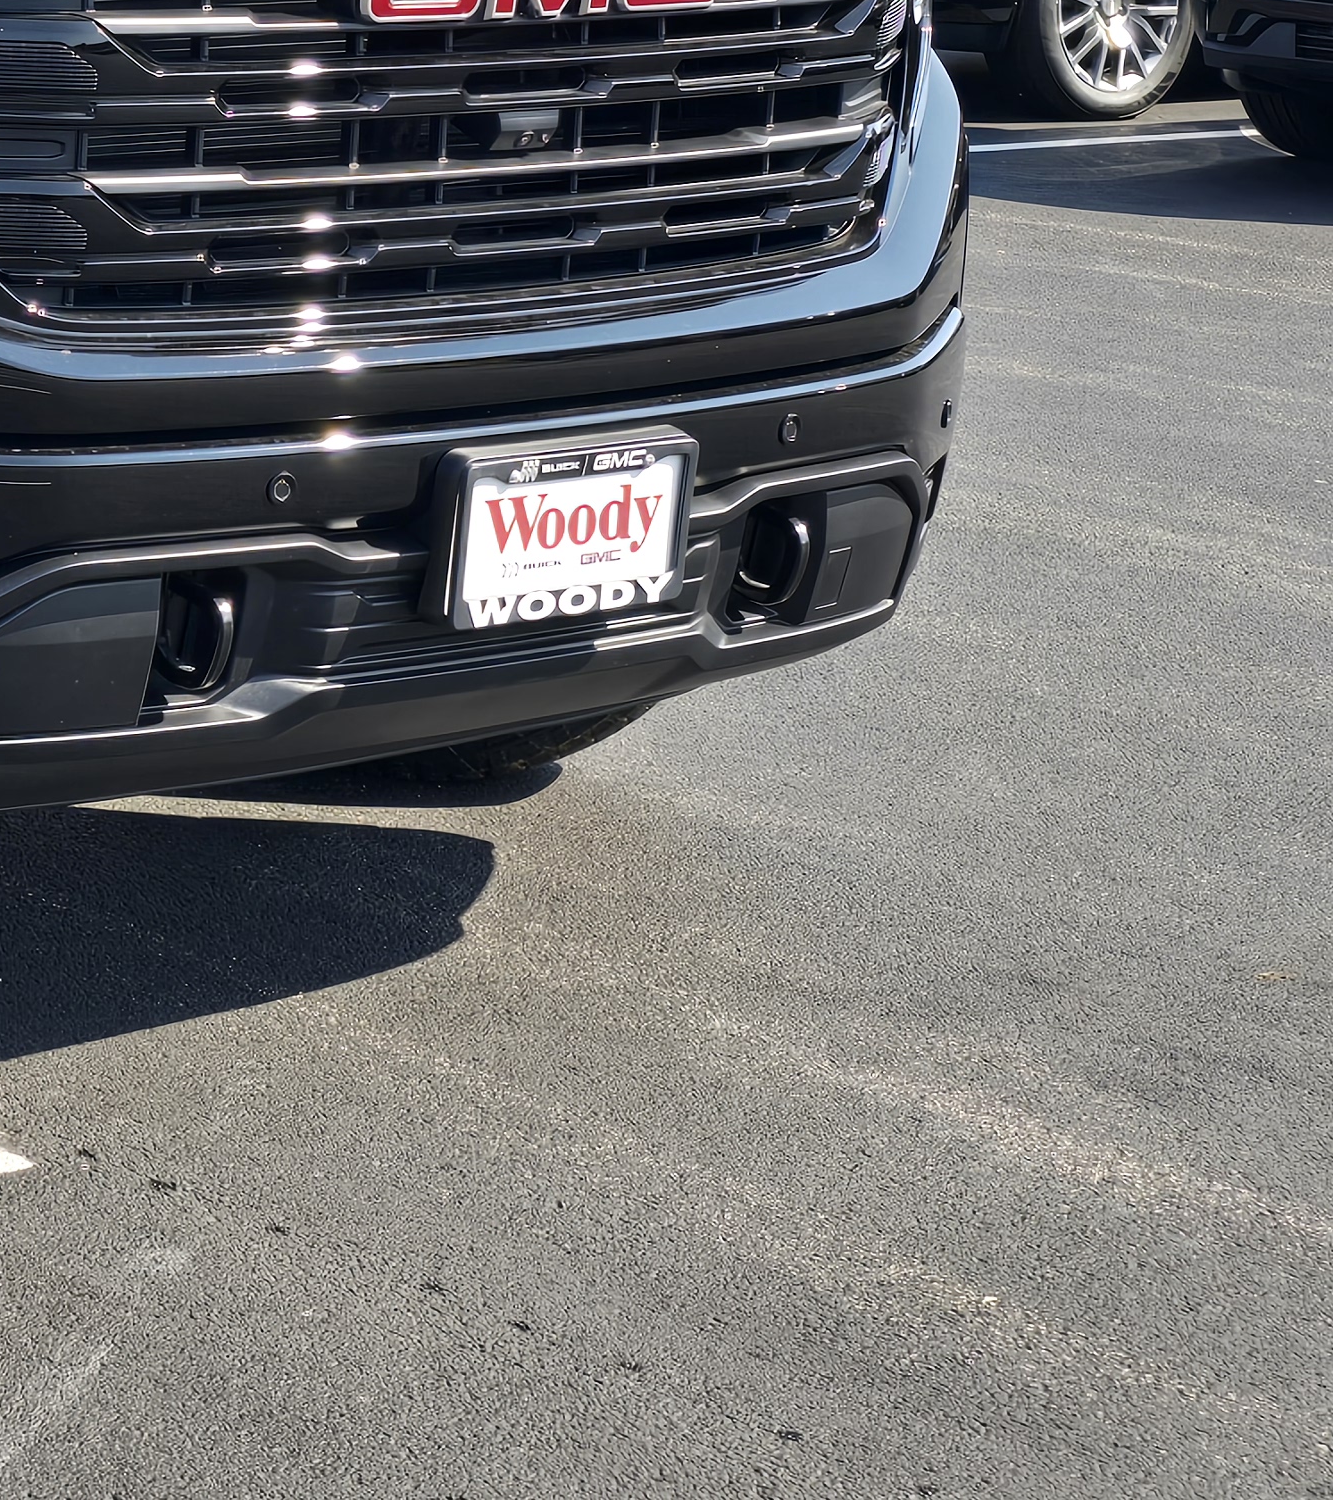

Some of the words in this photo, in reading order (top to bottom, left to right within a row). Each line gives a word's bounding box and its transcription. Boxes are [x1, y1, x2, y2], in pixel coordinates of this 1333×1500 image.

[592, 449, 648, 471] GMC
[485, 485, 663, 553] Woody
[580, 549, 621, 565] GMC
[467, 571, 674, 629] WOODY
